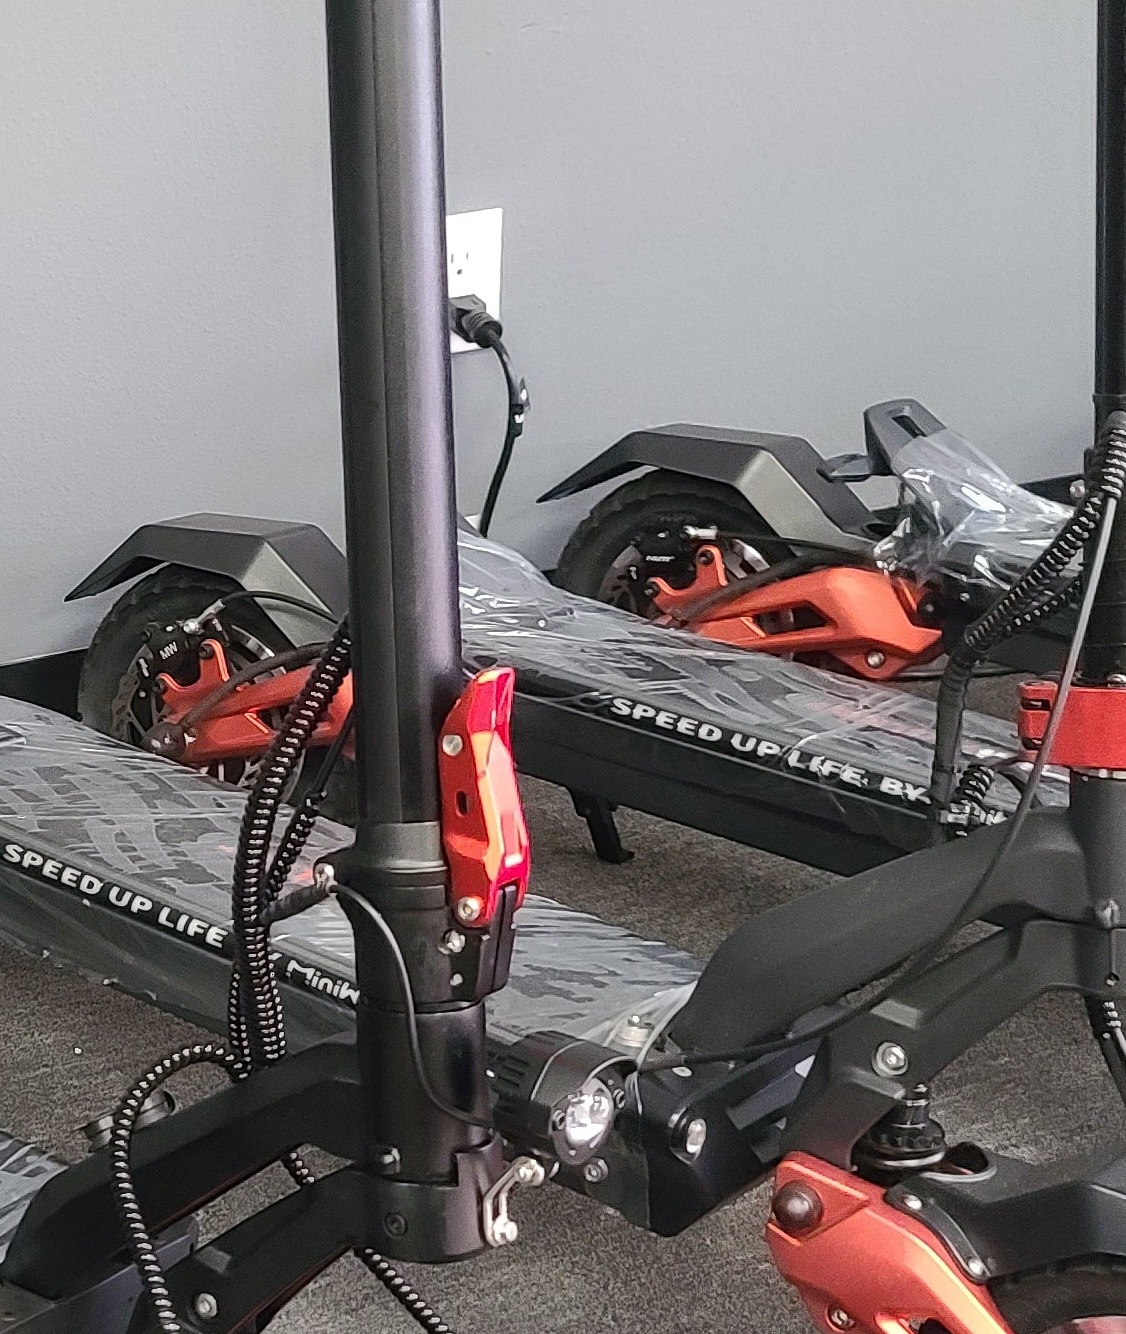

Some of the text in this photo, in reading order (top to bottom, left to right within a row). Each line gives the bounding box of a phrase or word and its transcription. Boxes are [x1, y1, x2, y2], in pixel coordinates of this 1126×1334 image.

[609, 696, 723, 743] SPEED
[730, 731, 784, 759] UP
[2, 843, 229, 949] SPEED UP LIFE
